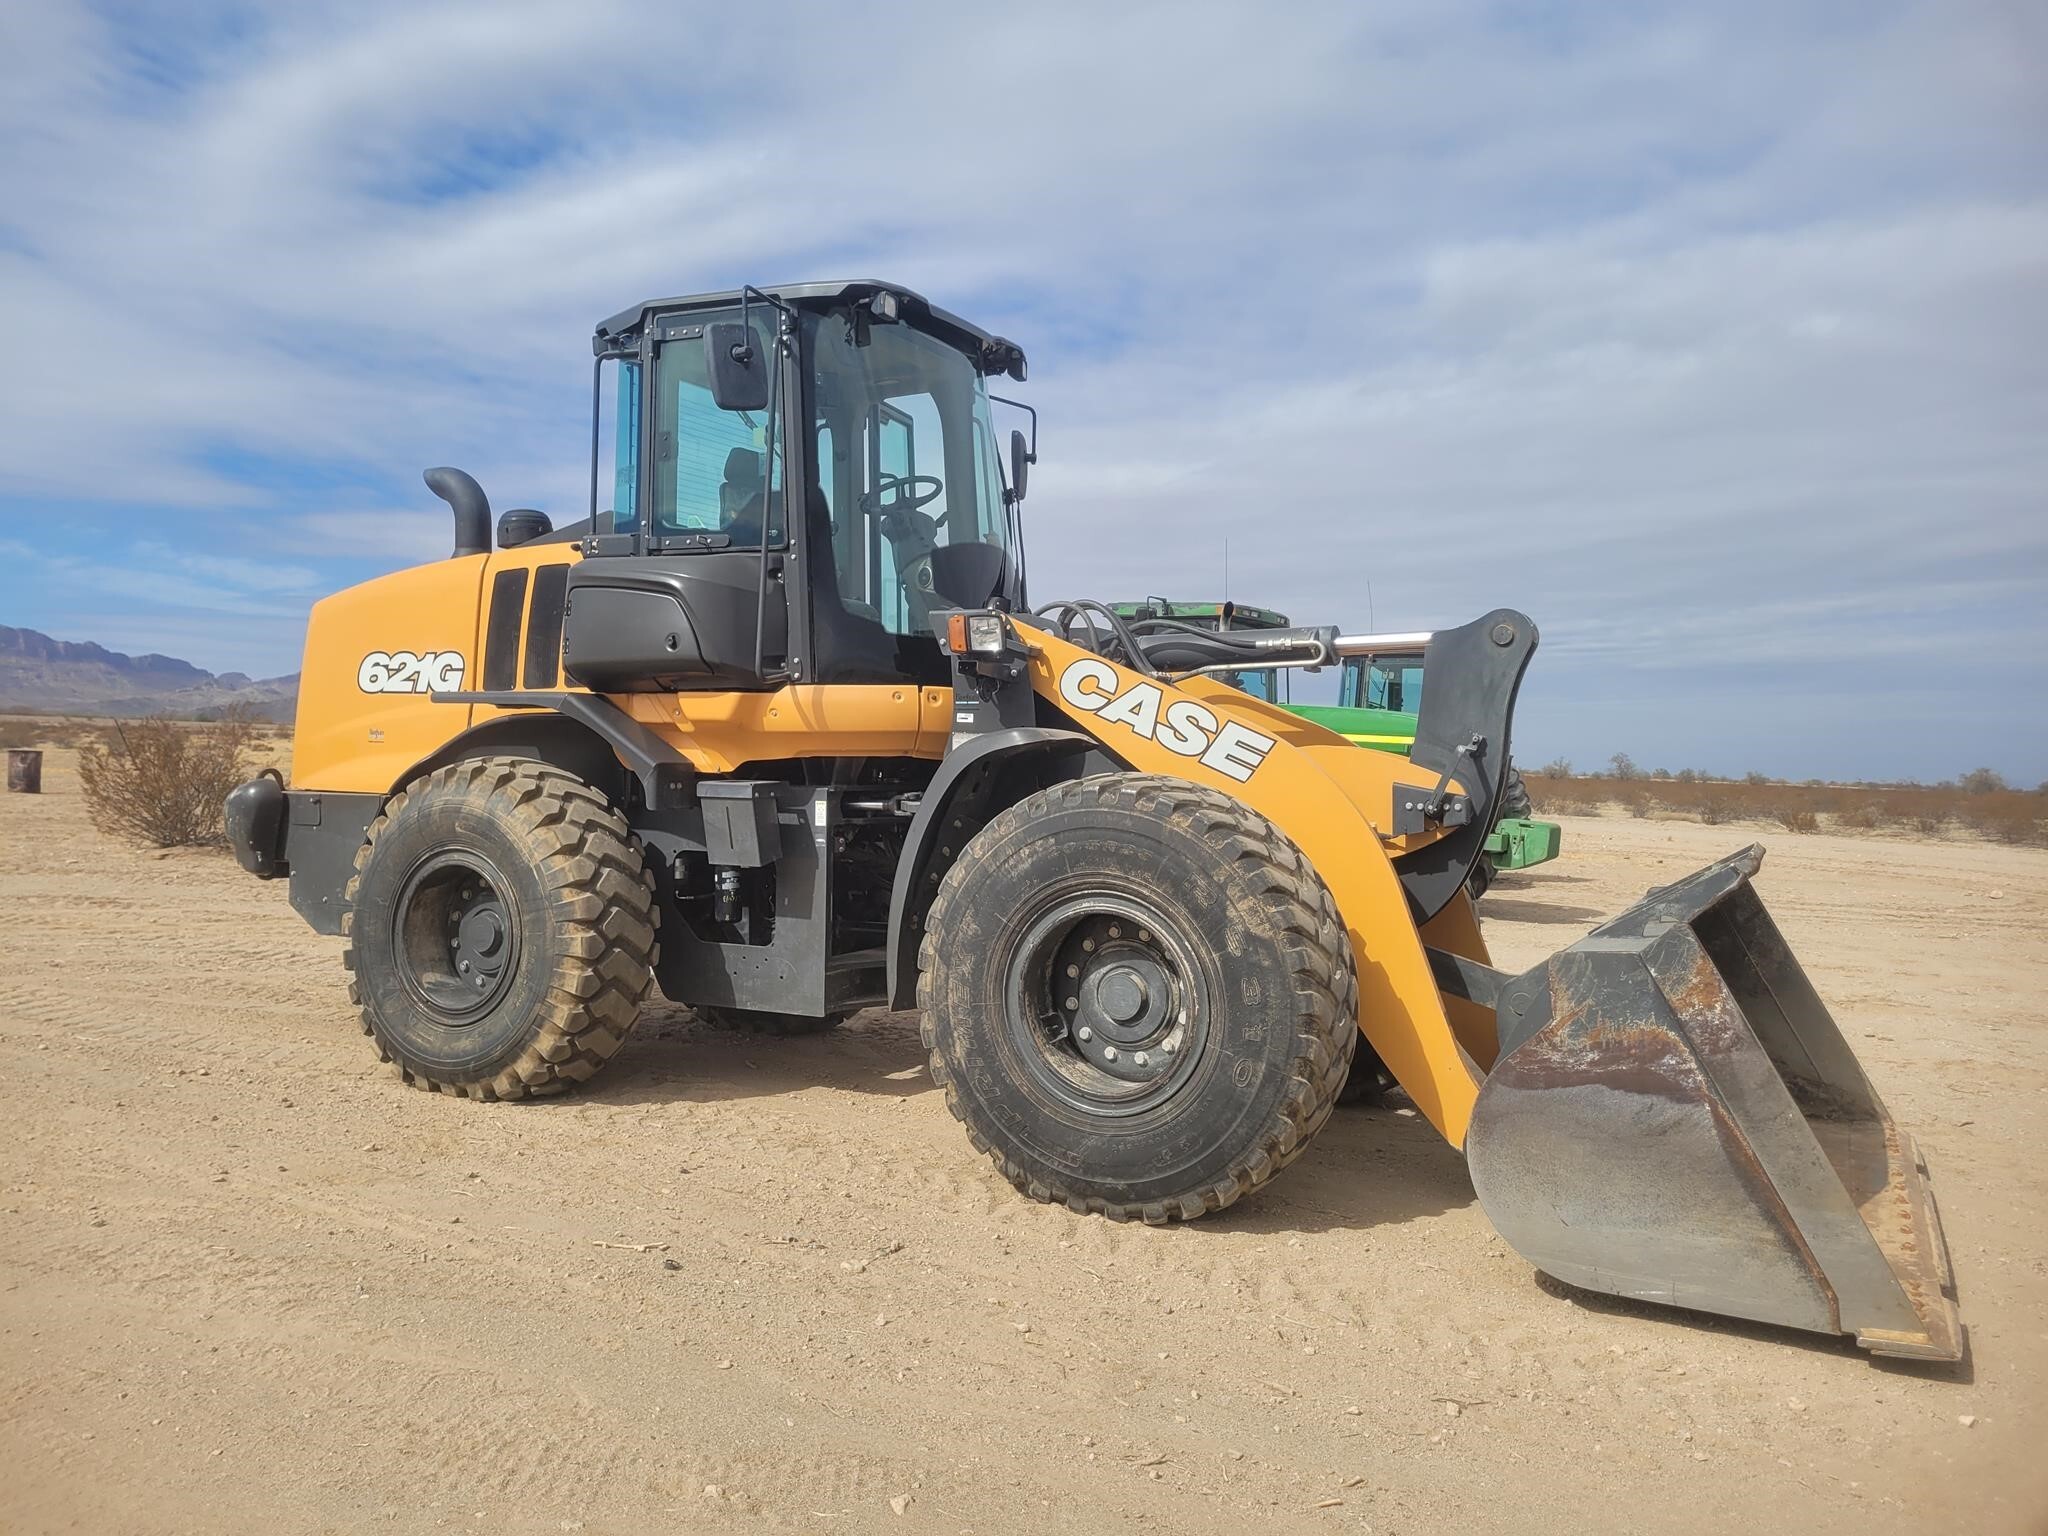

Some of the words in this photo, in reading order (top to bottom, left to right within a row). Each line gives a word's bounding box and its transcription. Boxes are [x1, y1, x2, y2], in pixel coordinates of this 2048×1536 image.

[357, 650, 465, 694] 621G
[1059, 658, 1278, 784] CASE
[953, 948, 1022, 1128] PRIMEX
